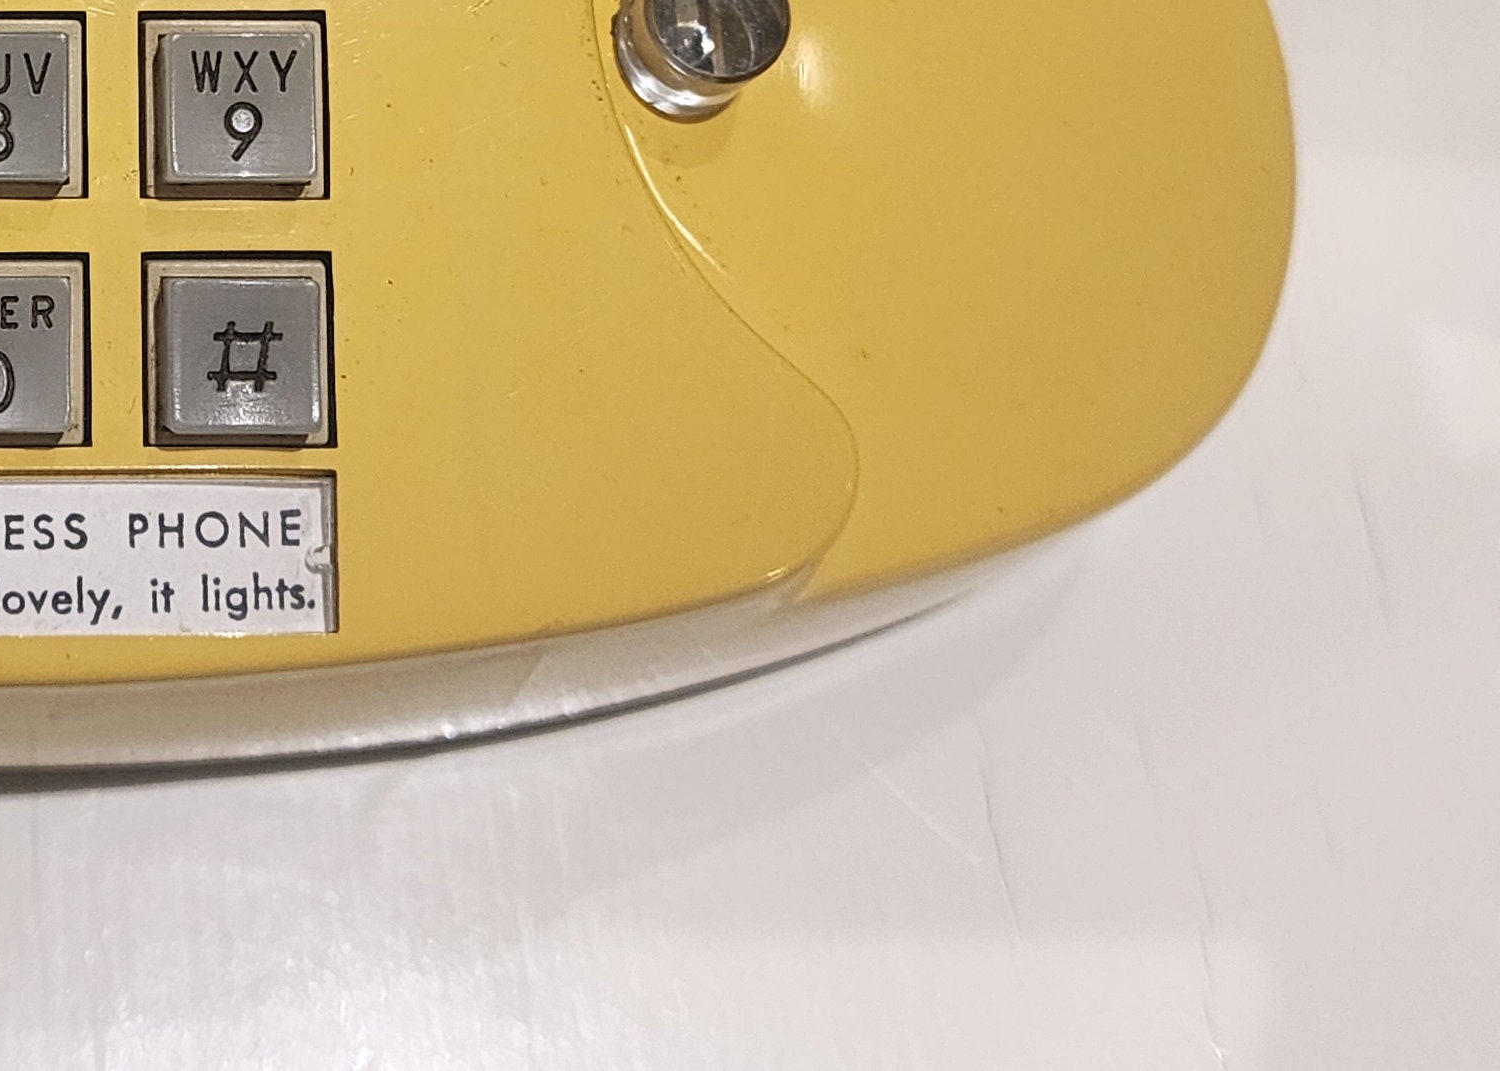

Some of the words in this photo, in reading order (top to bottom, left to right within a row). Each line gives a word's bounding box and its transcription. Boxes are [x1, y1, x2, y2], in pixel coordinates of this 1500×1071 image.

[190, 49, 297, 94] WXY
[223, 102, 263, 162] 9
[128, 508, 302, 549] PHONE
[150, 578, 175, 614] it
[201, 572, 316, 621] lights.
